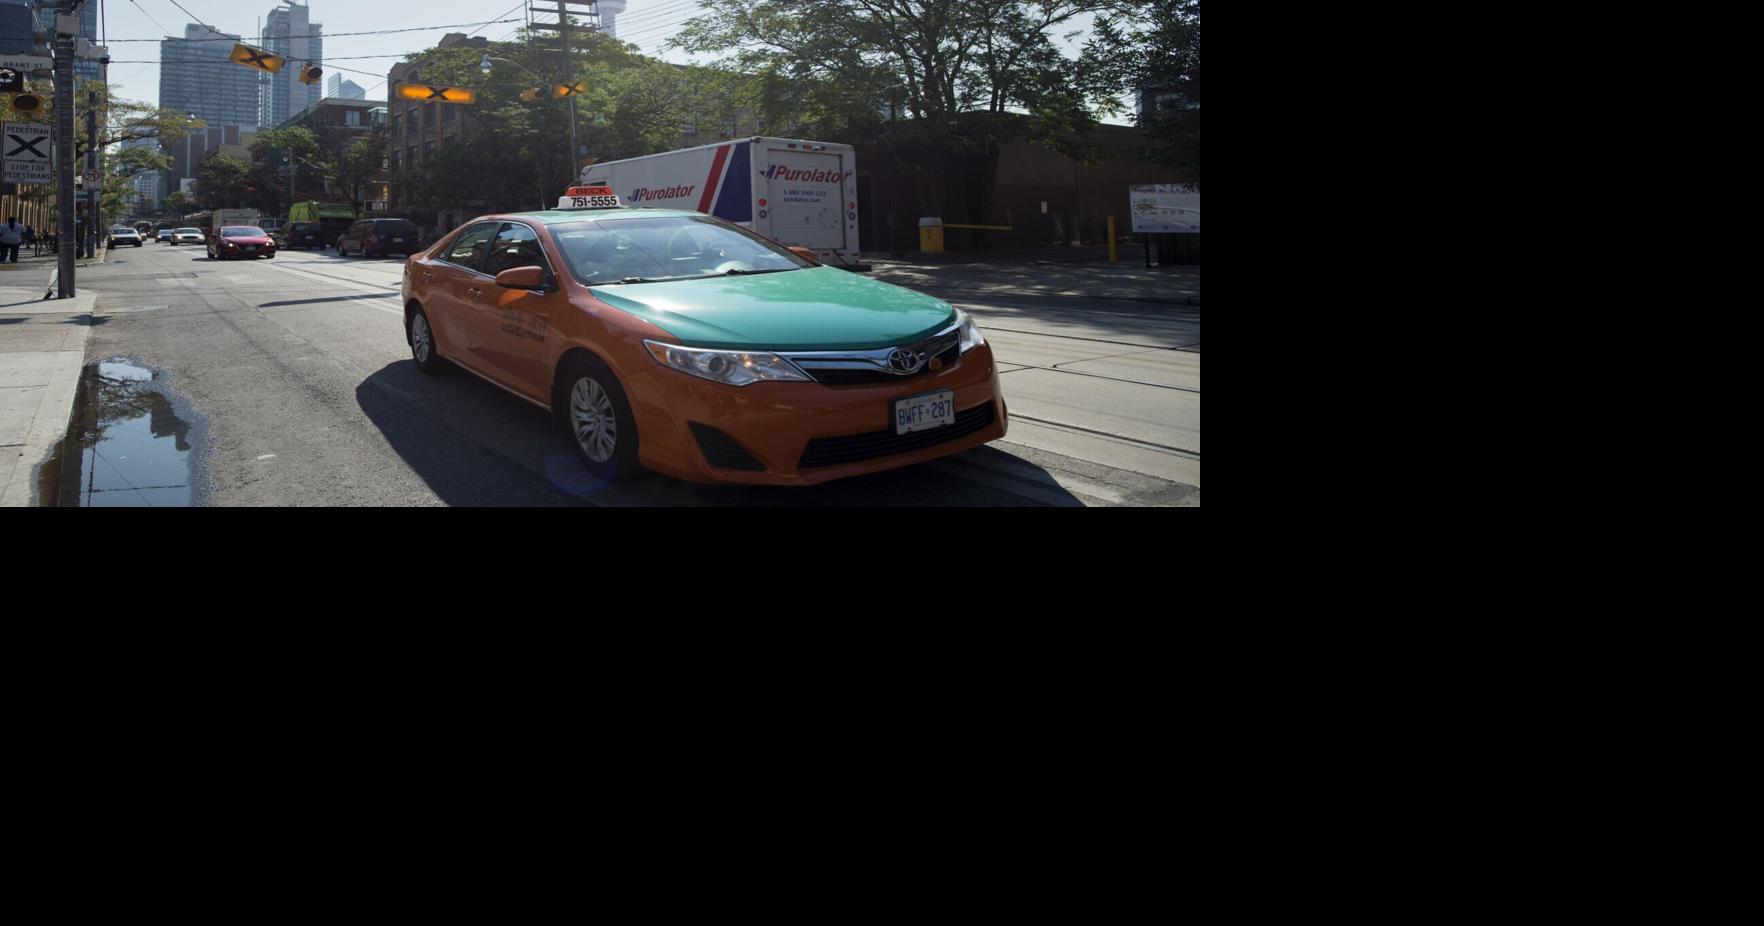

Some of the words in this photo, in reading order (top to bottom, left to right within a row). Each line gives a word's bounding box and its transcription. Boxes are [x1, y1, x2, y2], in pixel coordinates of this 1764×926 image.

[6, 126, 49, 135] PEDESTRIAN
[4, 171, 50, 180] PEDESTRIANS
[774, 165, 853, 184] Purolator
[575, 187, 608, 195] BECK
[639, 185, 696, 201] Purolator
[570, 196, 618, 207] 751-5555
